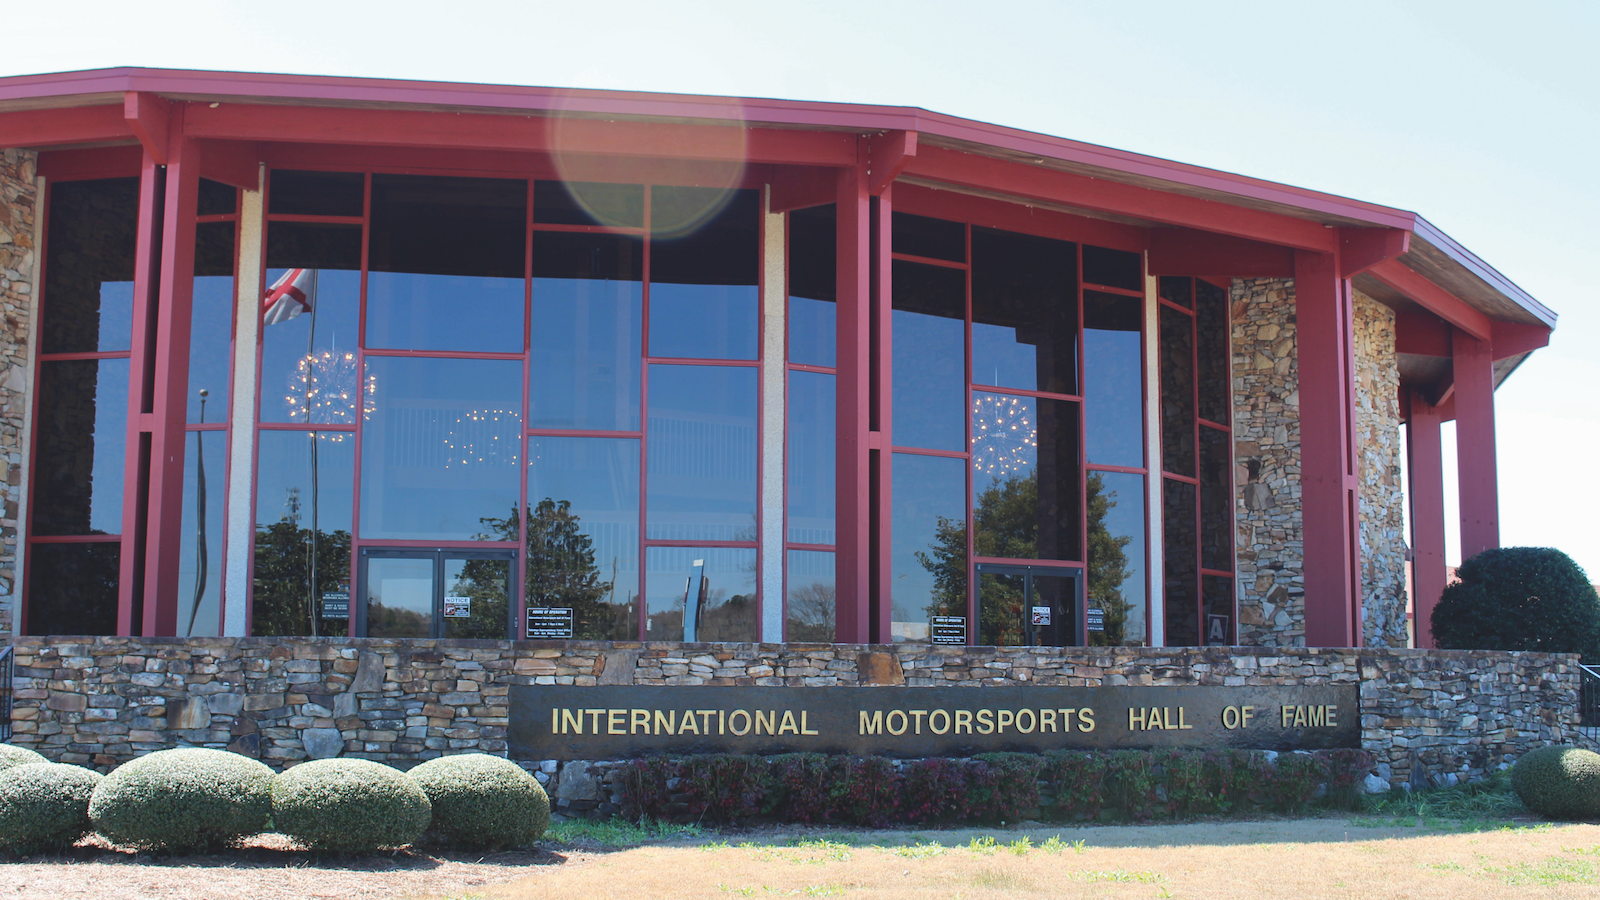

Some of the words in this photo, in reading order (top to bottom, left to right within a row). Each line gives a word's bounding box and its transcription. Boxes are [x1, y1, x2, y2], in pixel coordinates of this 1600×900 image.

[1210, 619, 1223, 639] A
[552, 708, 818, 736] INTERNATIONAL
[859, 708, 1096, 736] MOTORSPORTS
[1128, 706, 1193, 731] HALL
[1222, 706, 1254, 729] OF
[1282, 705, 1338, 727] FAME
